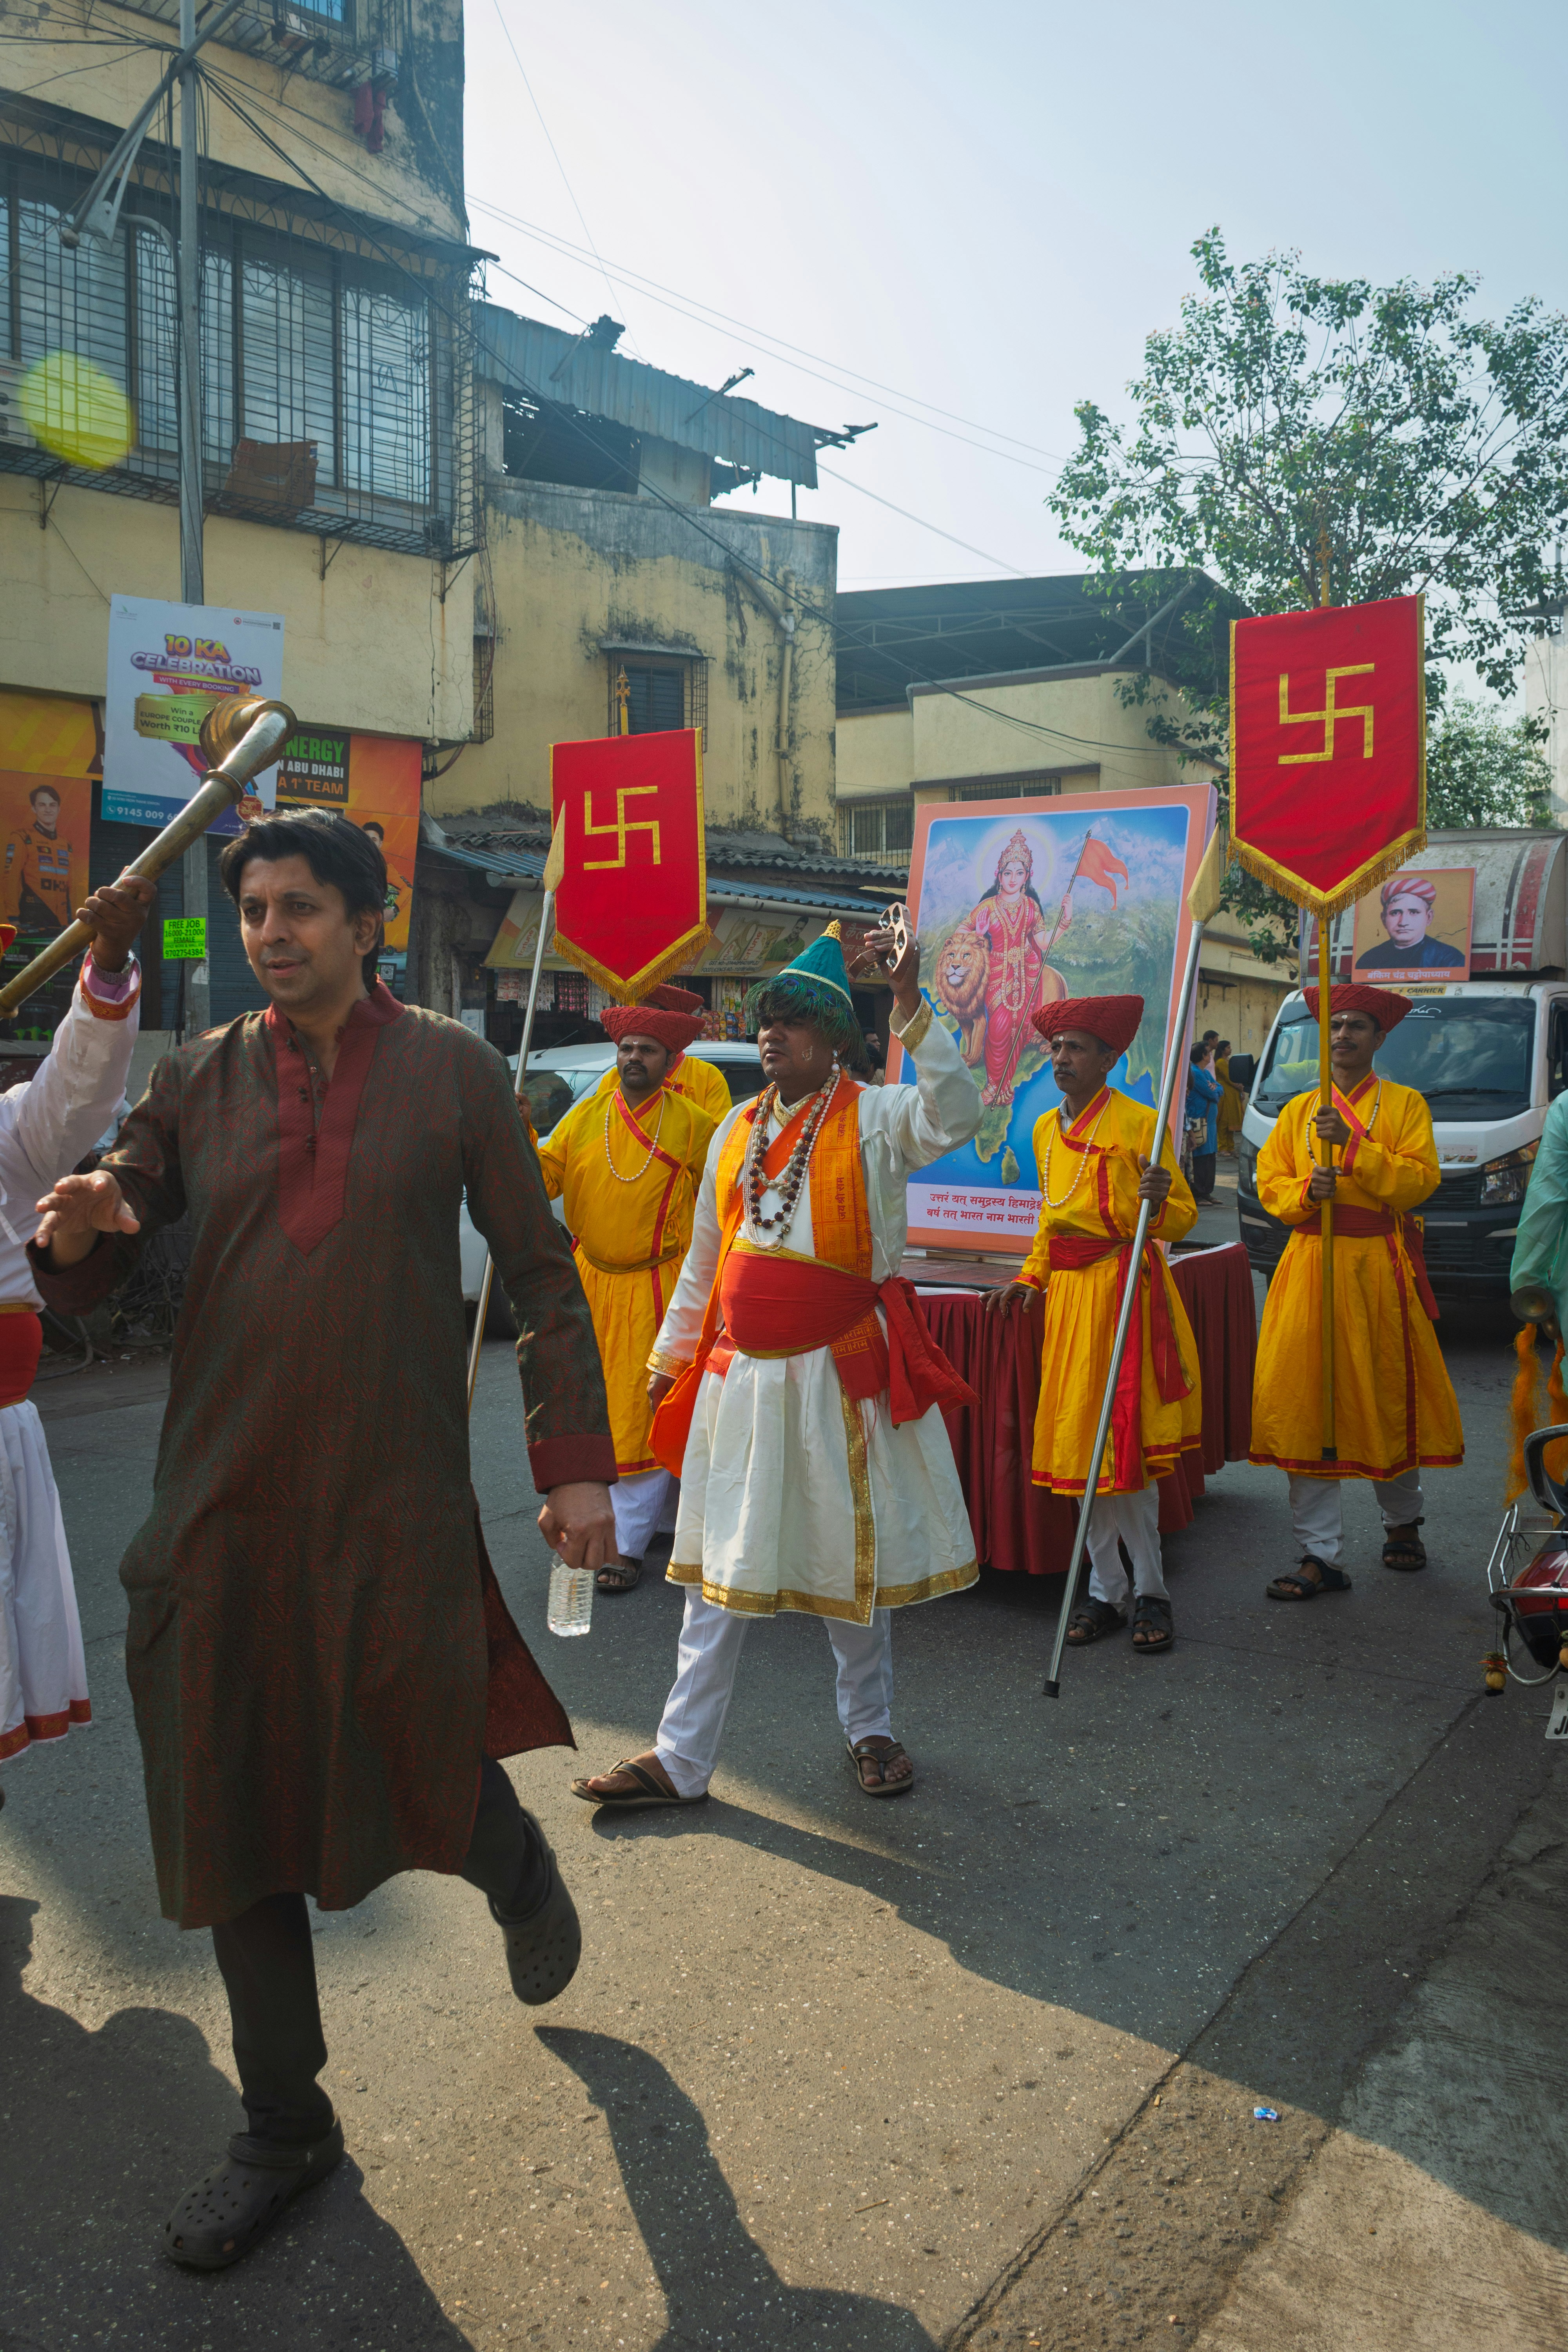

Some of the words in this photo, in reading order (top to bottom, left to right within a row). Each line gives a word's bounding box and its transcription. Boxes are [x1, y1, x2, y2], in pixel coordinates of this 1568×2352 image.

[165, 634, 191, 655] 10
[195, 639, 230, 661] KA
[131, 652, 262, 685] CELEBRATION
[202, 682, 234, 692] BOOKING
[140, 711, 170, 720] EUROPE
[172, 716, 201, 725] COUPLE
[171, 707, 187, 715] Win
[140, 719, 171, 730] Worth
[174, 724, 190, 733] ₹10
[283, 735, 345, 763] NERGY
[287, 760, 309, 774] ABU
[312, 763, 344, 779] DHABI
[305, 779, 343, 795] TEAM
[117, 806, 142, 817] 9145
[145, 810, 164, 820] 009
[169, 921, 184, 929] FREE
[186, 920, 201, 929] JOB
[165, 928, 205, 937] 16000-21000
[742, 931, 763, 960] ortune
[1367, 970, 1390, 979] बंकिम
[1393, 970, 1405, 979] चंद्र
[1407, 969, 1450, 980] चट्टोपाध्याय
[837, 1123, 846, 1137] जय
[835, 1193, 845, 1203] श्री
[930, 1191, 949, 1203] उत्तरं
[952, 1195, 967, 1207] यत्
[970, 1196, 1005, 1208] समुद्रस्य
[838, 1205, 846, 1220] जय
[927, 1206, 941, 1218] वर्ष
[943, 1210, 958, 1221] तत्
[960, 1210, 984, 1221] भारत
[986, 1213, 1005, 1222] नाम
[1007, 1213, 1035, 1225] भारती
[852, 1339, 868, 1350] राम
